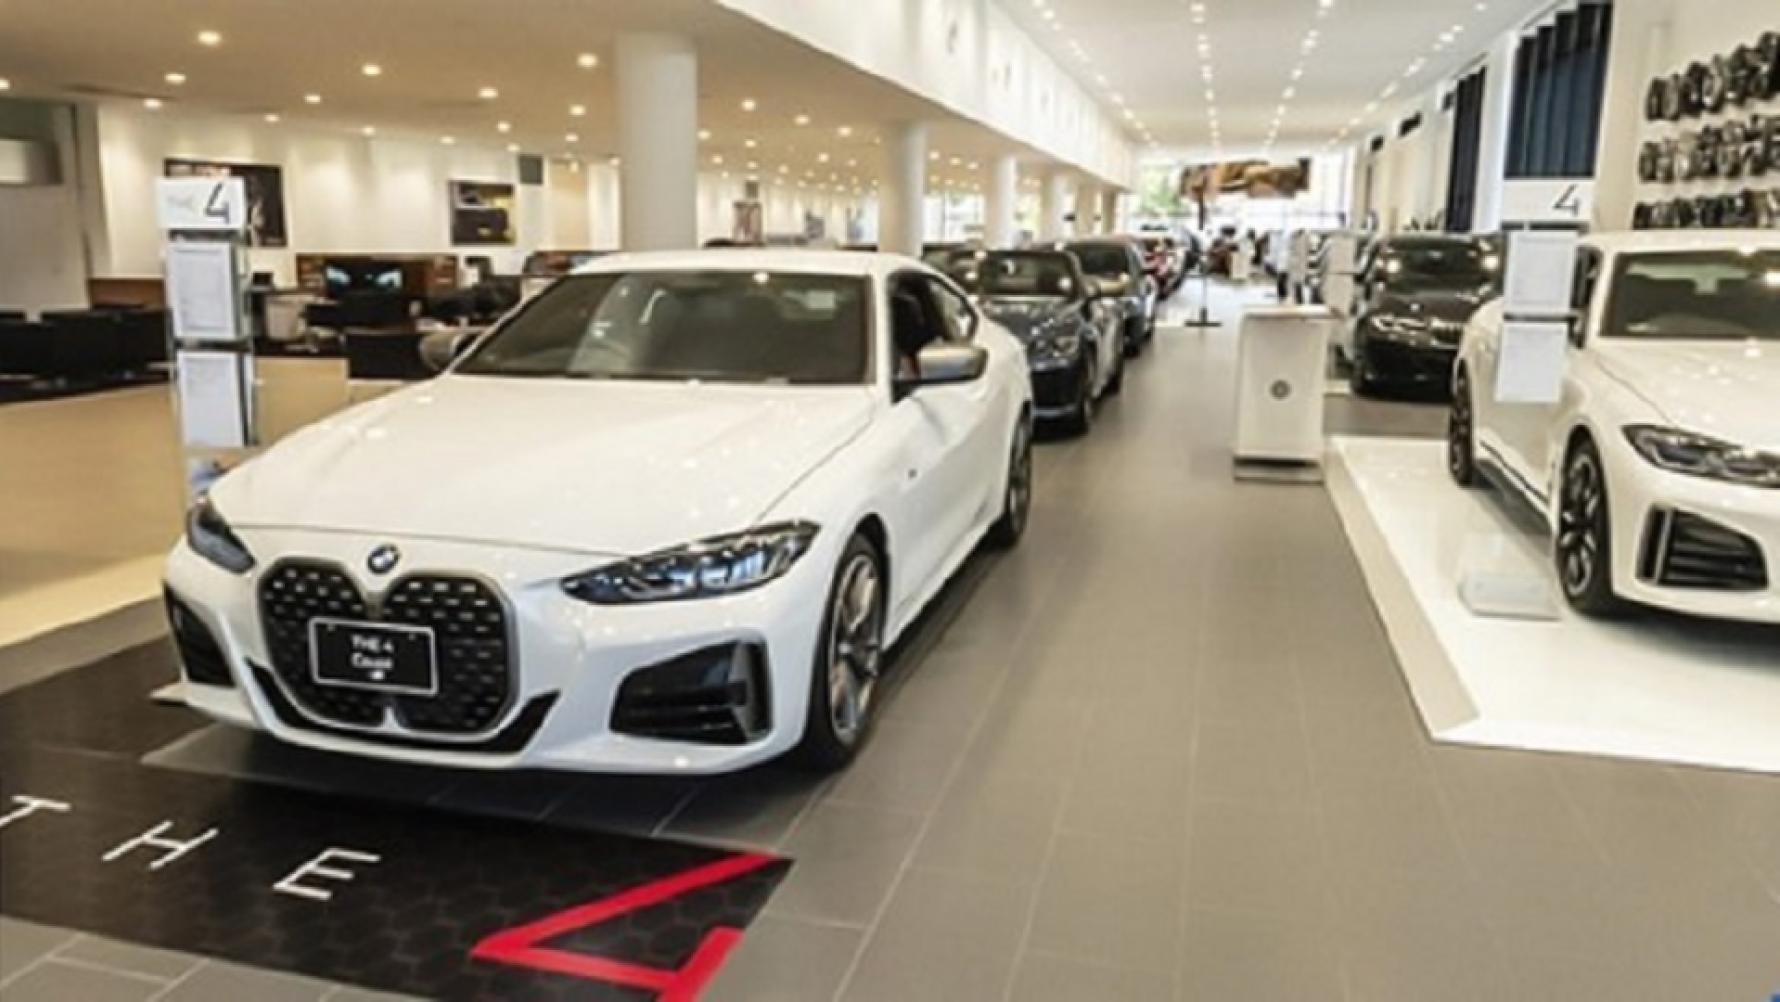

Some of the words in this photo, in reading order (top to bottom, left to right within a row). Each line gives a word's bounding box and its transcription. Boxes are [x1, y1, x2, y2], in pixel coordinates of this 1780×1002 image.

[204, 182, 230, 224] 4
[1553, 184, 1580, 217] 4
[469, 850, 778, 1002] 4
